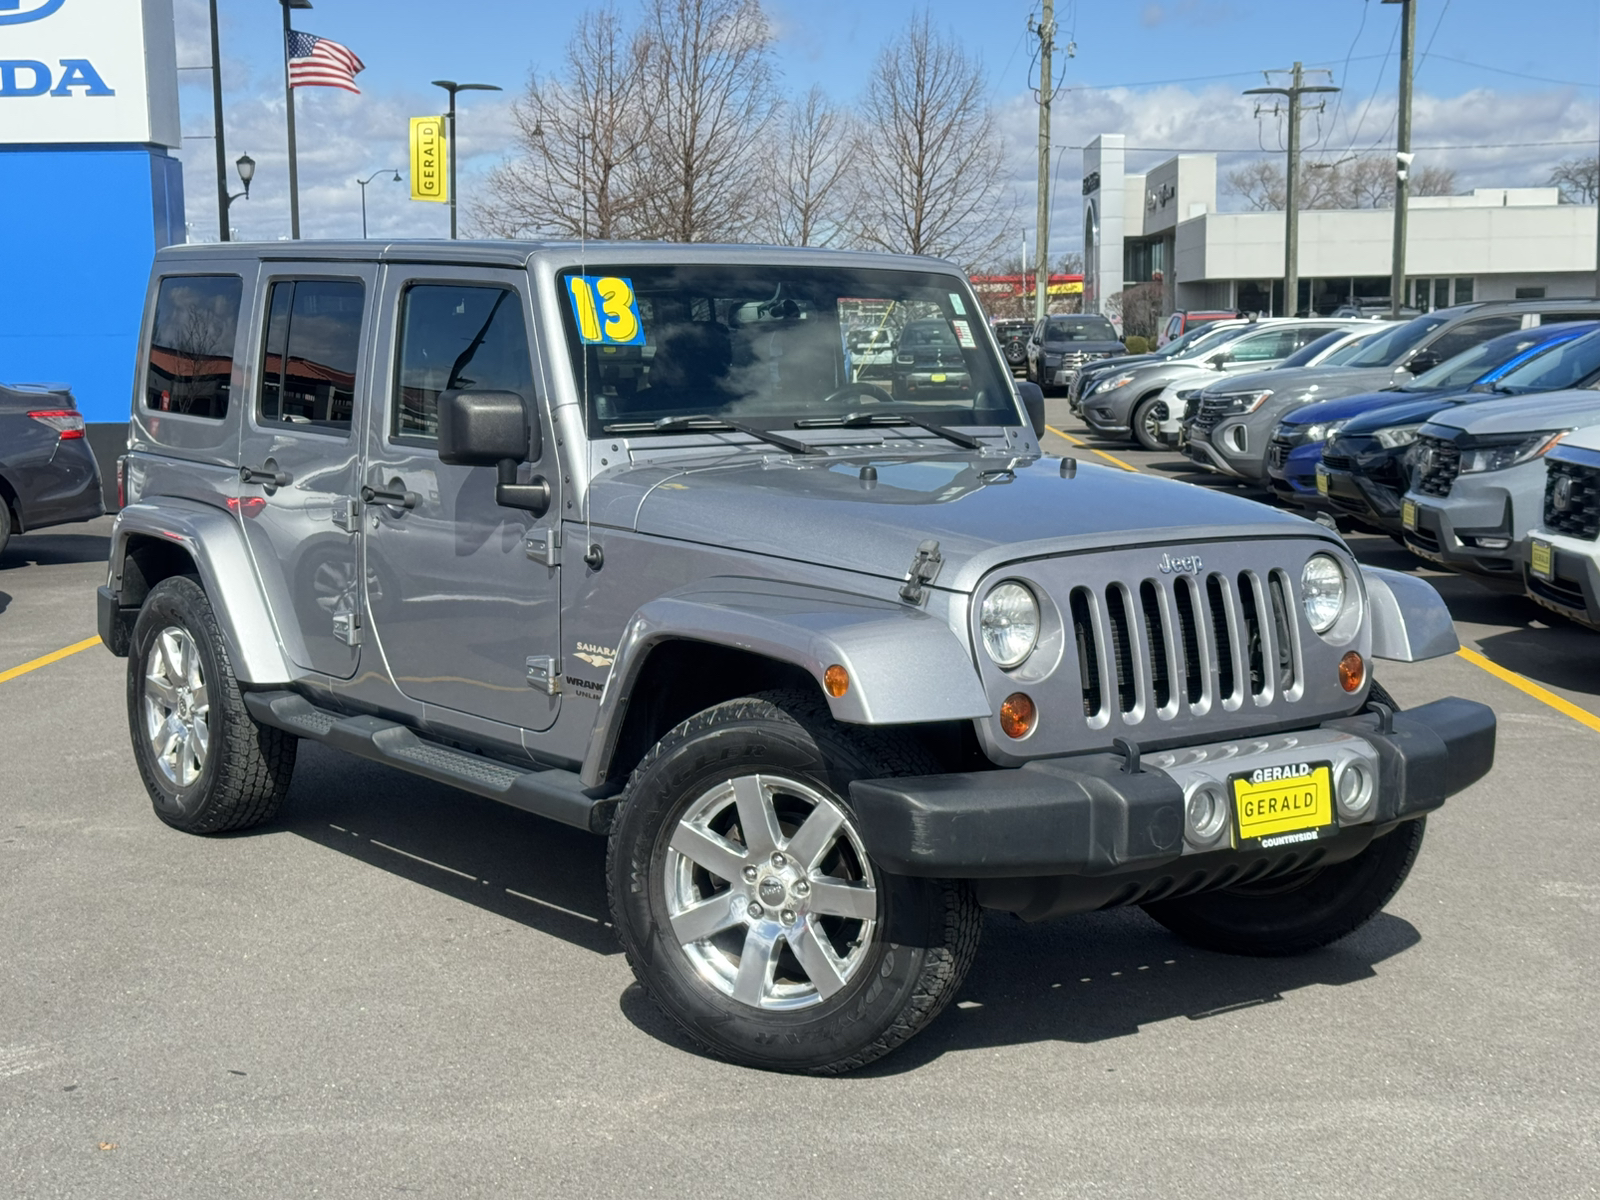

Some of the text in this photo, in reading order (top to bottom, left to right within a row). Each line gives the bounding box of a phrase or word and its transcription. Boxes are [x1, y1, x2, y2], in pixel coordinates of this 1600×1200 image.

[423, 127, 435, 190] GERALD
[571, 277, 639, 342] 13
[1157, 552, 1204, 576] Jeep
[576, 641, 616, 656] SAHARA
[1253, 763, 1310, 783] GERALD
[1244, 792, 1314, 818] GERALD
[1261, 831, 1319, 848] COUNTRYSIDE
